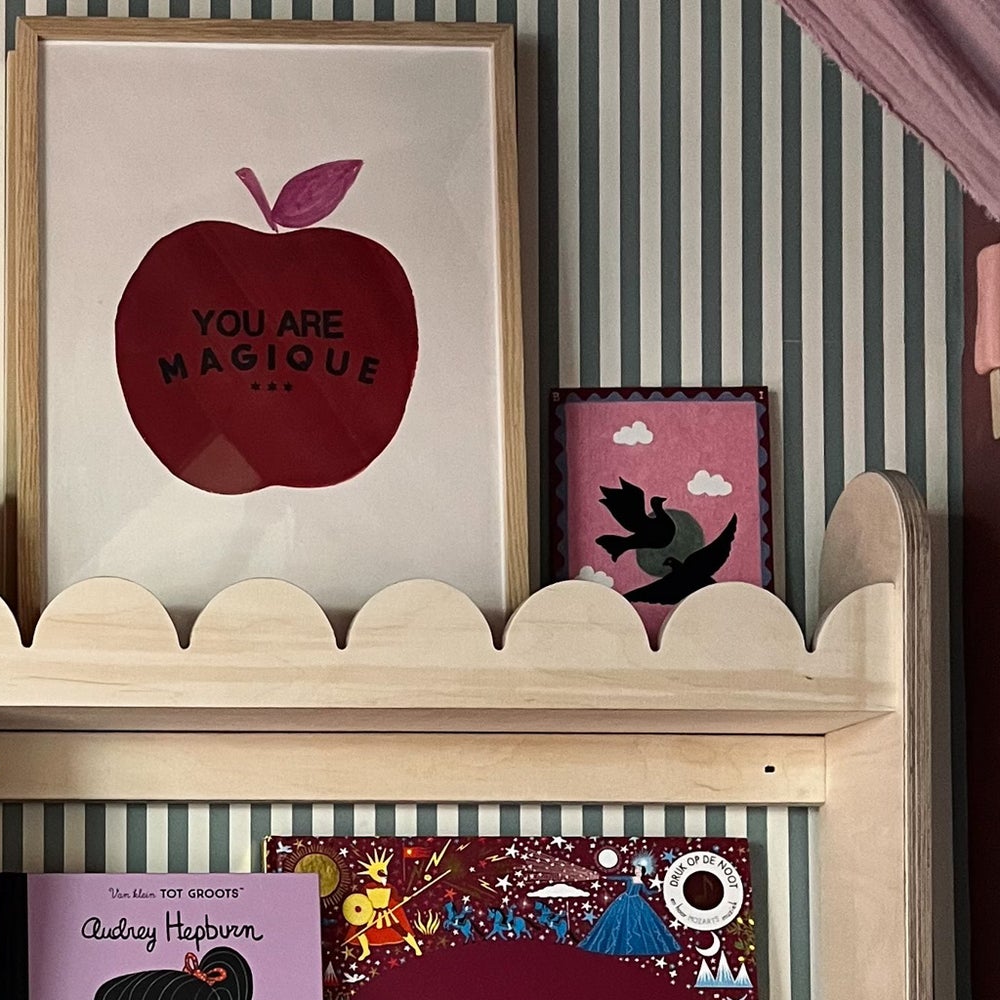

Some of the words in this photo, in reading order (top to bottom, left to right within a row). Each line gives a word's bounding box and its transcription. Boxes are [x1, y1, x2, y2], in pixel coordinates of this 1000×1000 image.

[192, 309, 265, 337] YOU
[276, 309, 344, 339] ARE
[157, 343, 380, 385] MAGIQUE
[669, 863, 688, 888] DRUK
[686, 855, 700, 866] OP
[702, 855, 716, 865] DE
[717, 859, 738, 888] NOOT
[108, 888, 131, 899] Van
[132, 888, 156, 899] klein
[160, 888, 183, 898] TOT
[81, 917, 157, 953] Audrey
[165, 910, 264, 952] Hepburn
